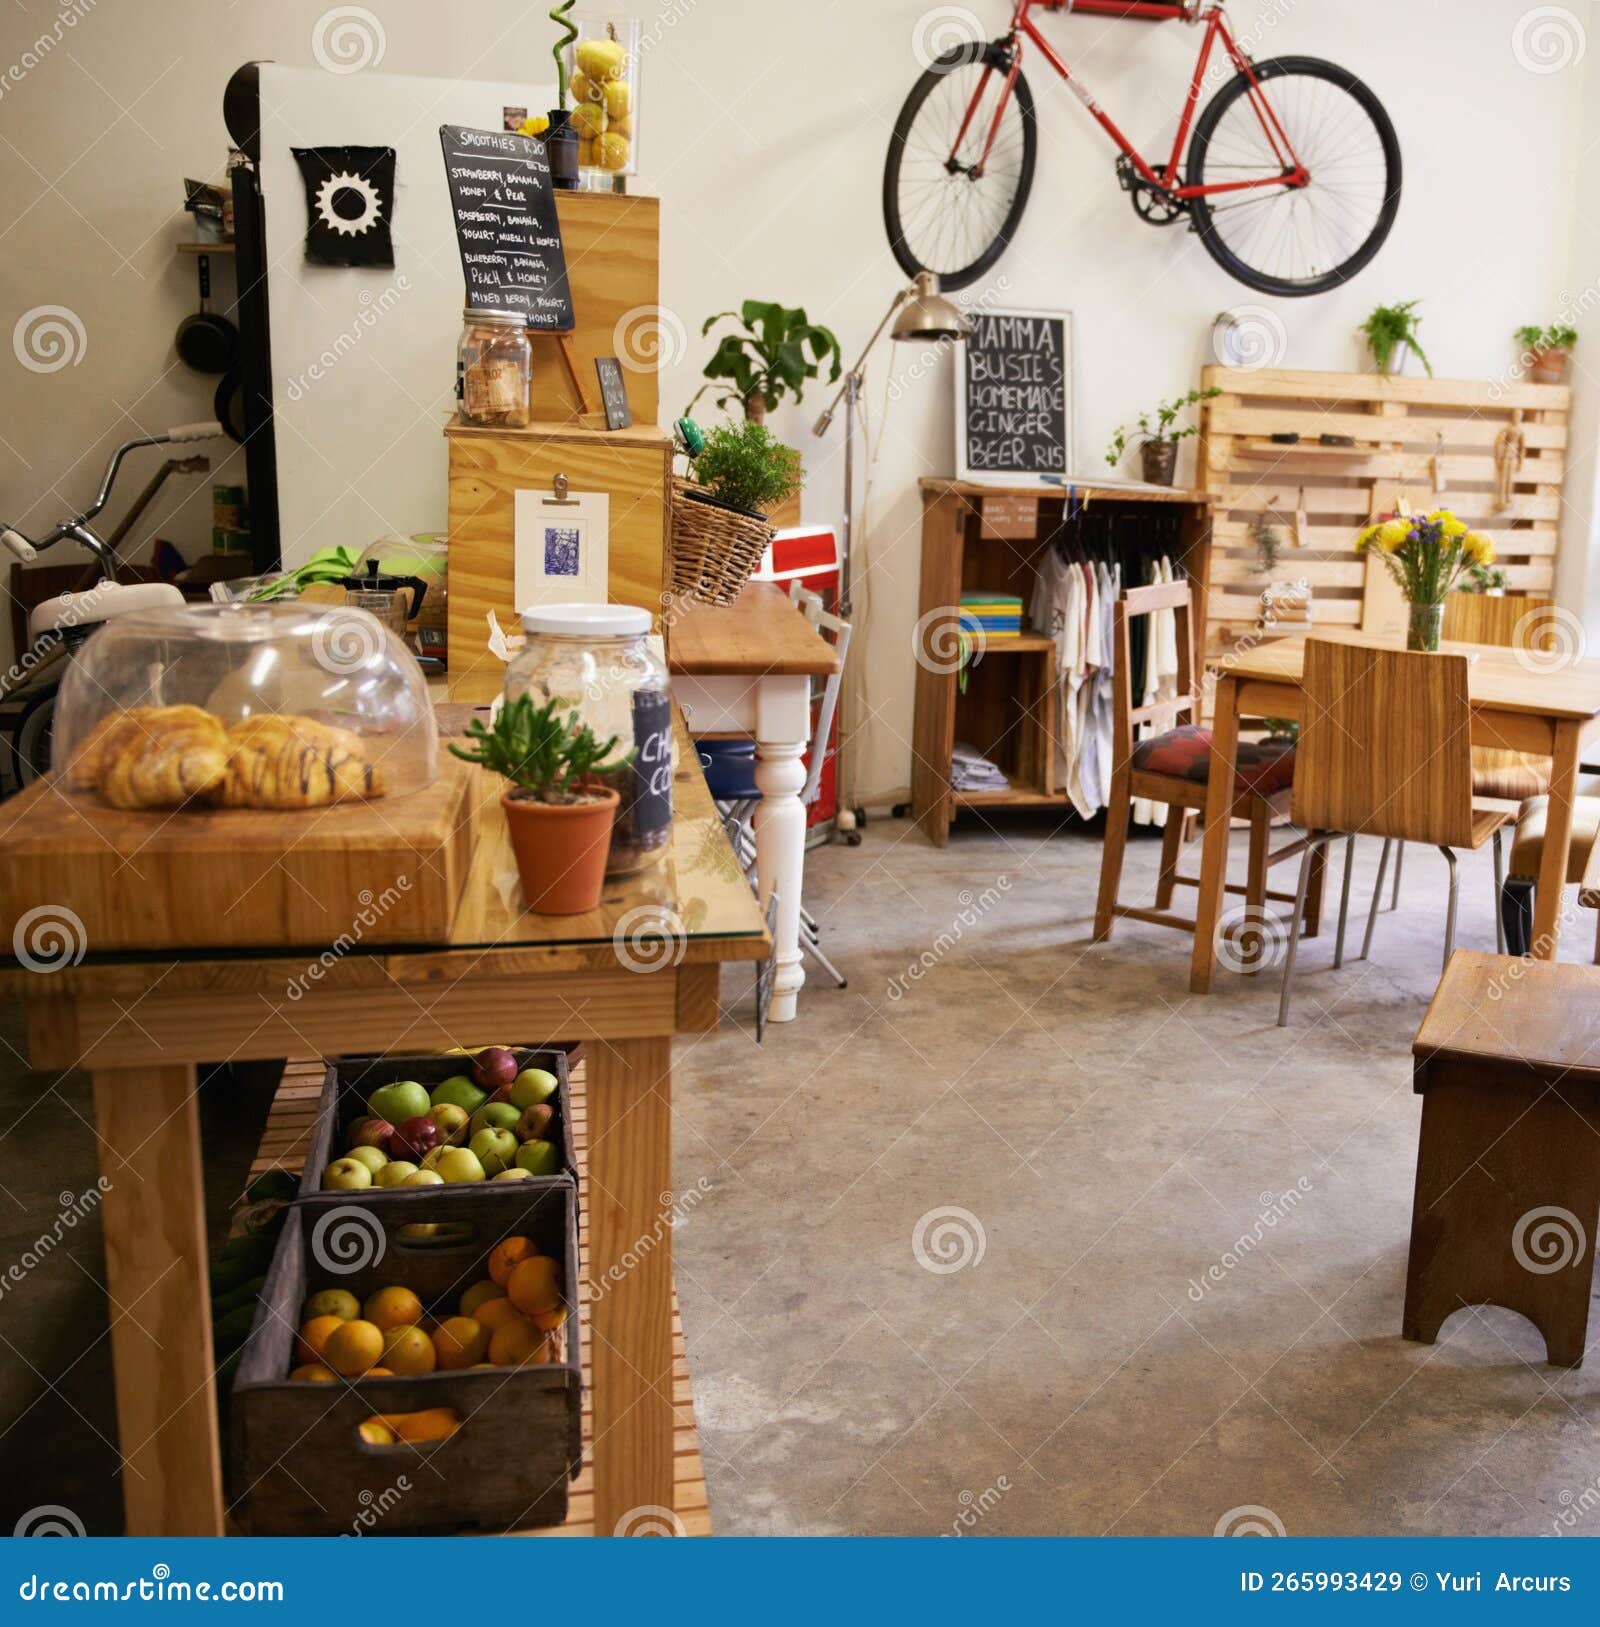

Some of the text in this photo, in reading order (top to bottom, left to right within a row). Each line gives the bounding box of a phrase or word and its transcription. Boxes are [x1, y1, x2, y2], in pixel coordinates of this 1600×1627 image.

[460, 131, 516, 152] SMOOTHIES
[459, 186, 487, 197] HONEY
[536, 236, 560, 249] HONEY
[471, 266, 501, 285] PEACH
[517, 272, 547, 285] HONEY
[471, 291, 500, 304] MIXED
[528, 313, 559, 324] HONEY
[966, 317, 1055, 353] MAMMA
[968, 351, 1063, 383] BUSIE'S
[968, 383, 1064, 412] HOMEMADE
[968, 409, 1053, 434] GINGER
[1032, 444, 1064, 468] R15
